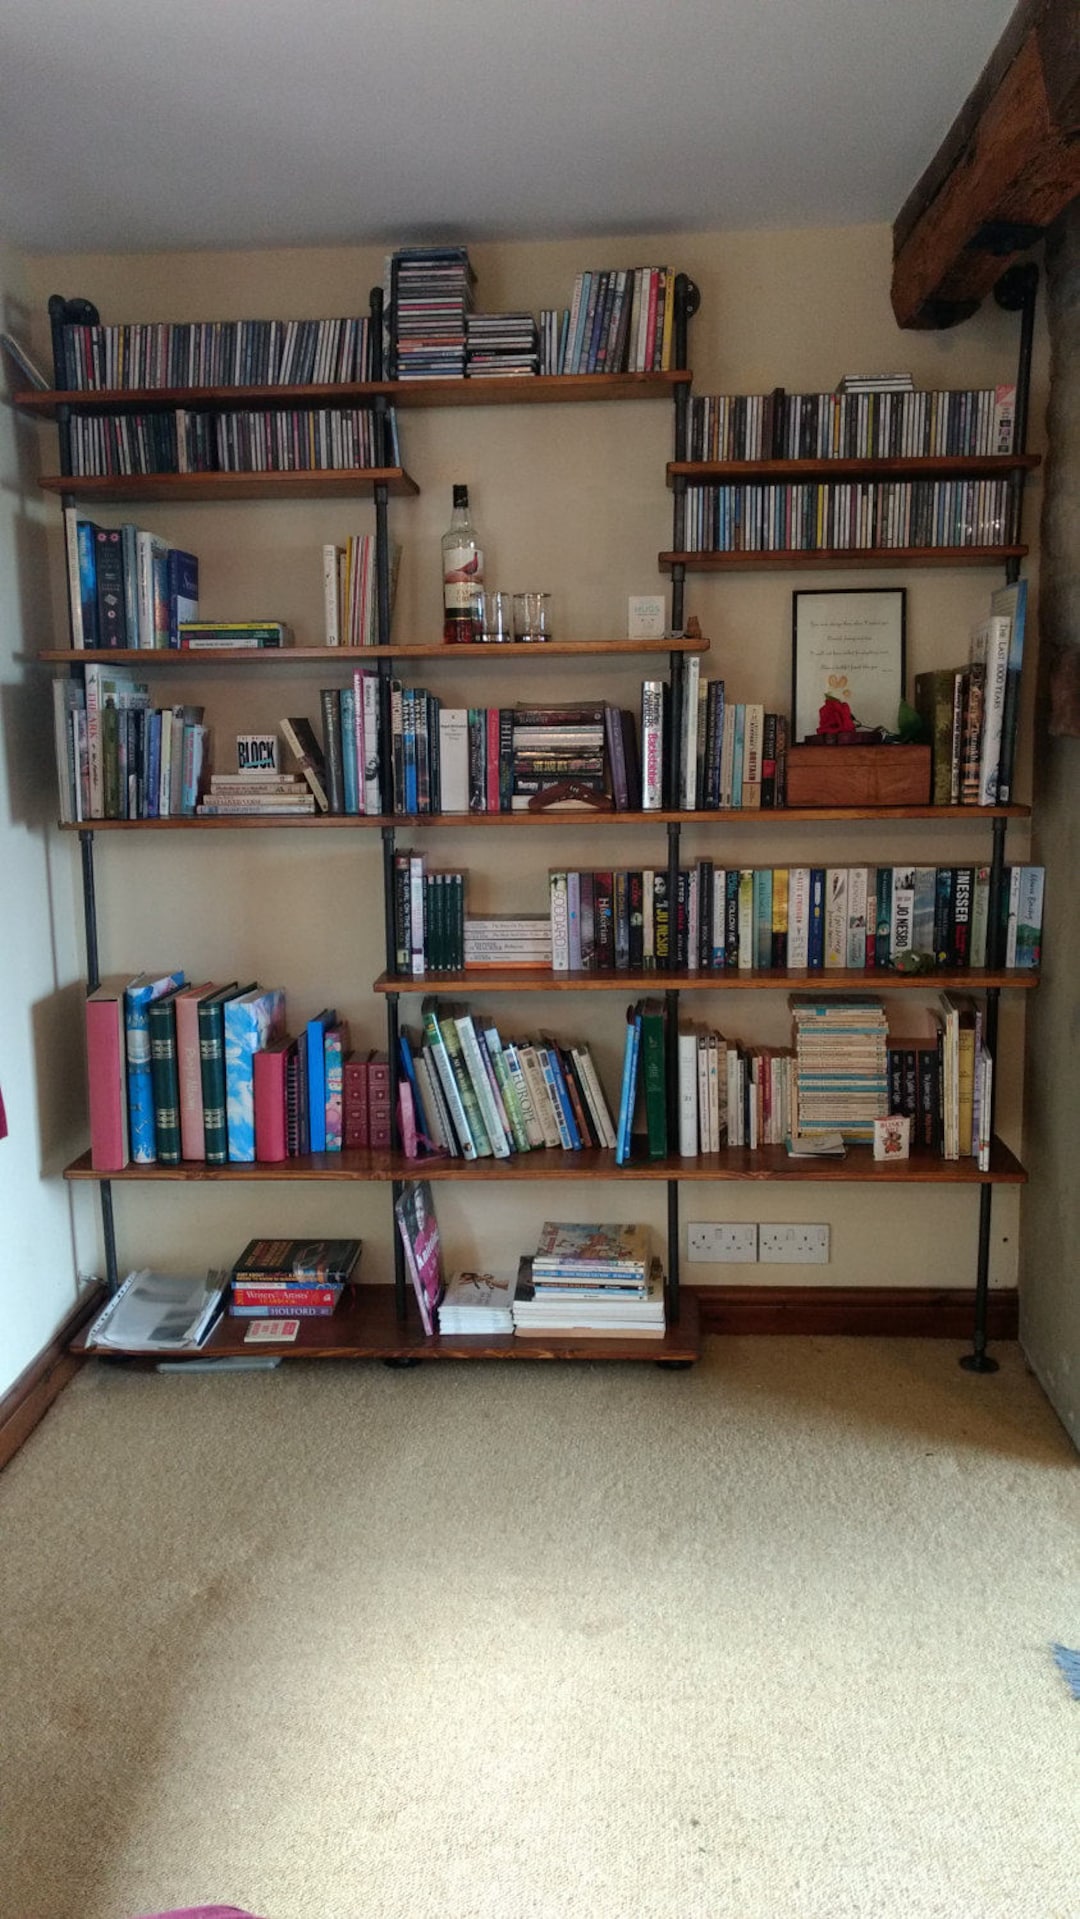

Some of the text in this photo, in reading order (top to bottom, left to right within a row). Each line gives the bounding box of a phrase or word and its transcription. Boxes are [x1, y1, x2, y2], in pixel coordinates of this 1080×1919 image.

[997, 642, 1006, 660] LAST
[996, 664, 1004, 684] 1000
[392, 691, 402, 734] WATCHMEN
[994, 686, 1002, 710] YEARS
[88, 717, 97, 739] ARK
[500, 724, 512, 755] HILL
[238, 741, 275, 768] BLOCK
[647, 733, 659, 787] Backstabber
[748, 752, 756, 780] BRITAIN
[954, 876, 970, 922] NESSER
[554, 890, 566, 946] GODDARD
[598, 898, 610, 944] Historian
[896, 904, 910, 948] JO NESBO
[728, 932, 736, 942] ME
[513, 1074, 536, 1124] EUROPE
[270, 1308, 316, 1316] HOLFORD
